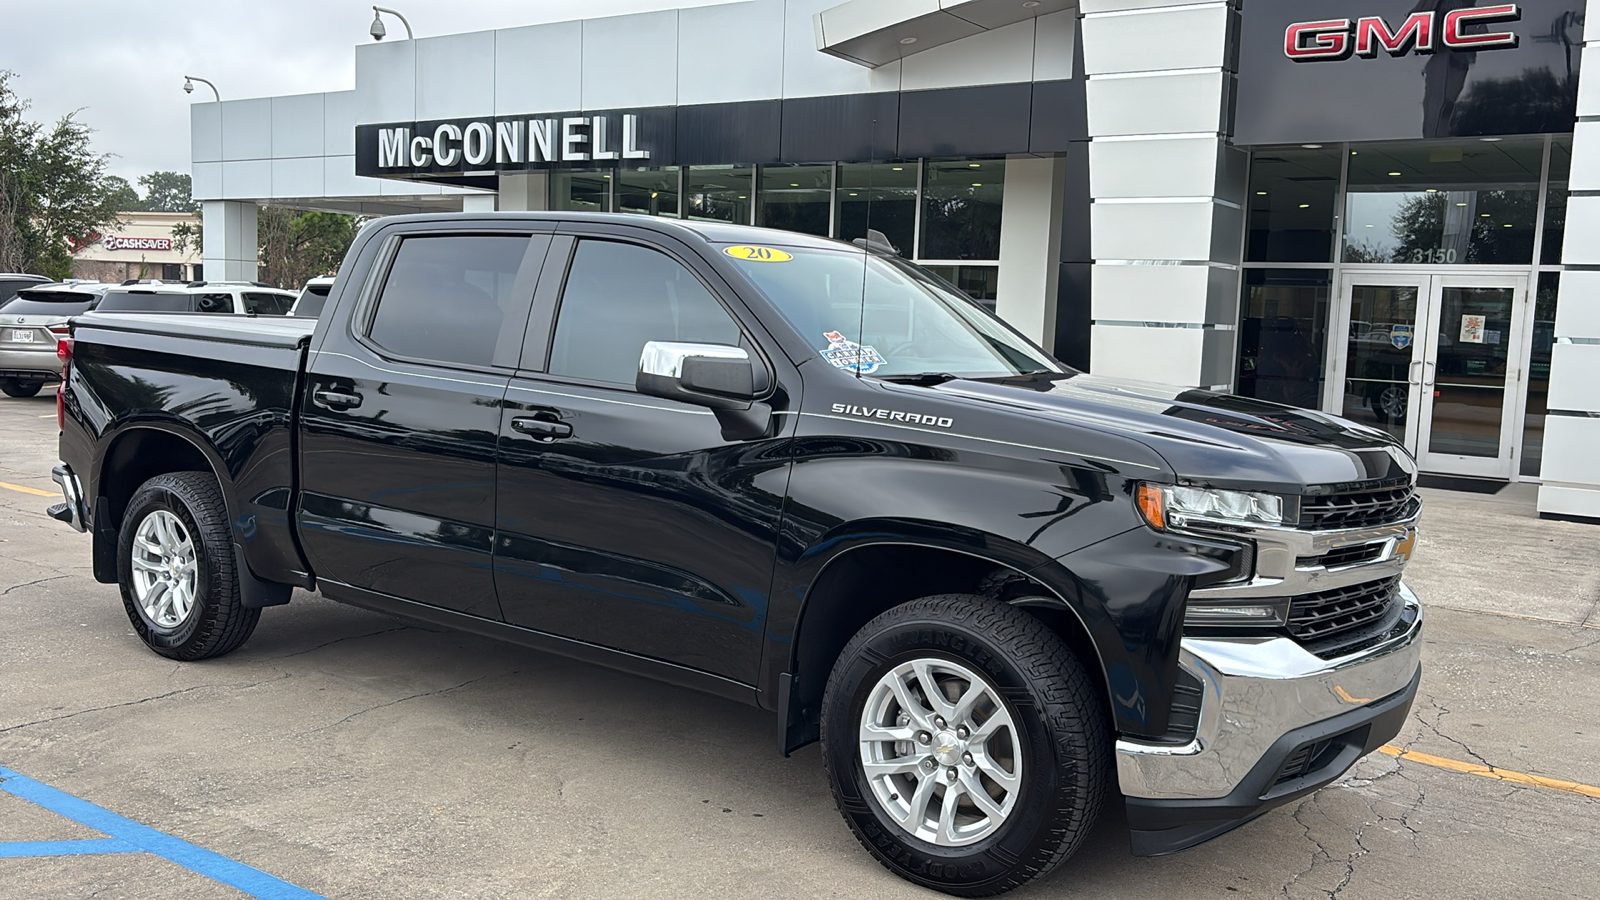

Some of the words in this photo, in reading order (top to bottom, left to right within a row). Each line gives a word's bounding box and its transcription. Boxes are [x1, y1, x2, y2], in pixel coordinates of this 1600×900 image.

[1284, 4, 1518, 59] GMC
[378, 114, 650, 168] McCONNELL
[115, 238, 169, 249] CASHSAVER
[743, 247, 771, 259] 20
[1412, 248, 1457, 264] 3150
[831, 403, 954, 428] SILVERADO
[887, 629, 1004, 676] WRANGLER
